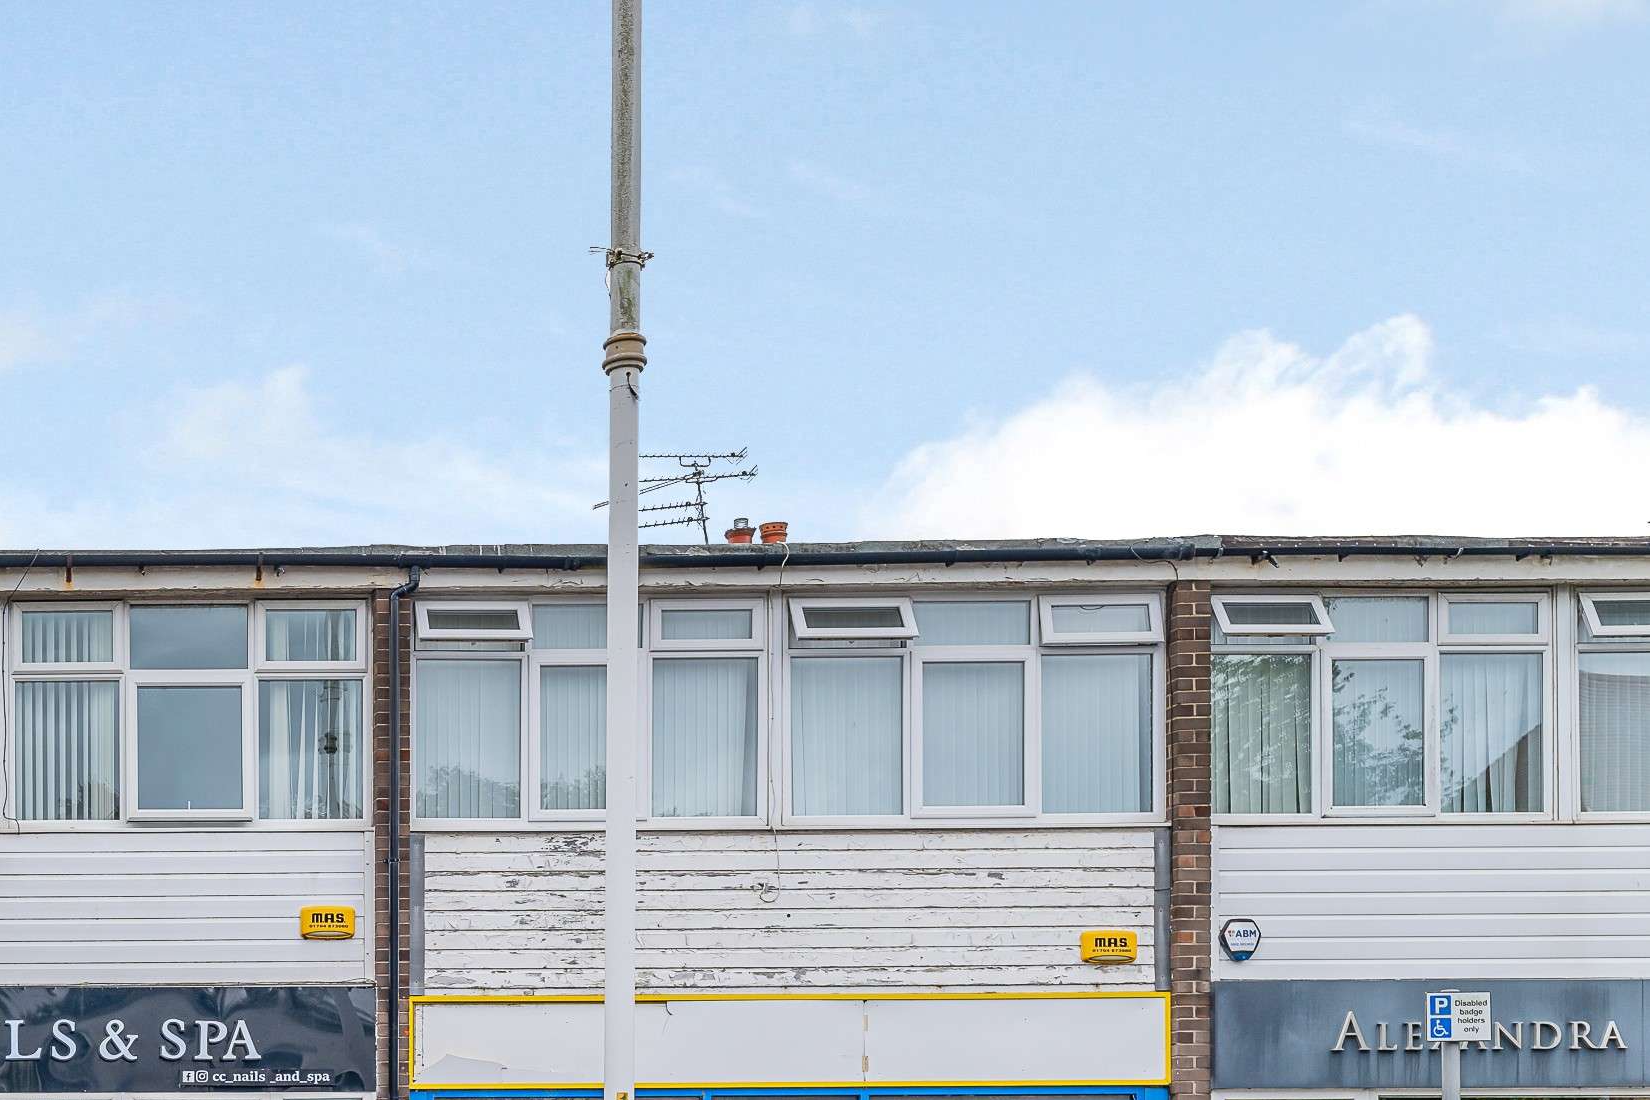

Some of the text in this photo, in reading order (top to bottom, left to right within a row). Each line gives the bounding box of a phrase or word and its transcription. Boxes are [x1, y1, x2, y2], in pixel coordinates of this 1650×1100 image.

[1235, 929, 1257, 937] ABM
[98, 1018, 138, 1062] &
[158, 1018, 263, 1062] SPA
[1329, 1011, 1628, 1051] ALENDRA
[1463, 1025, 1480, 1034] only
